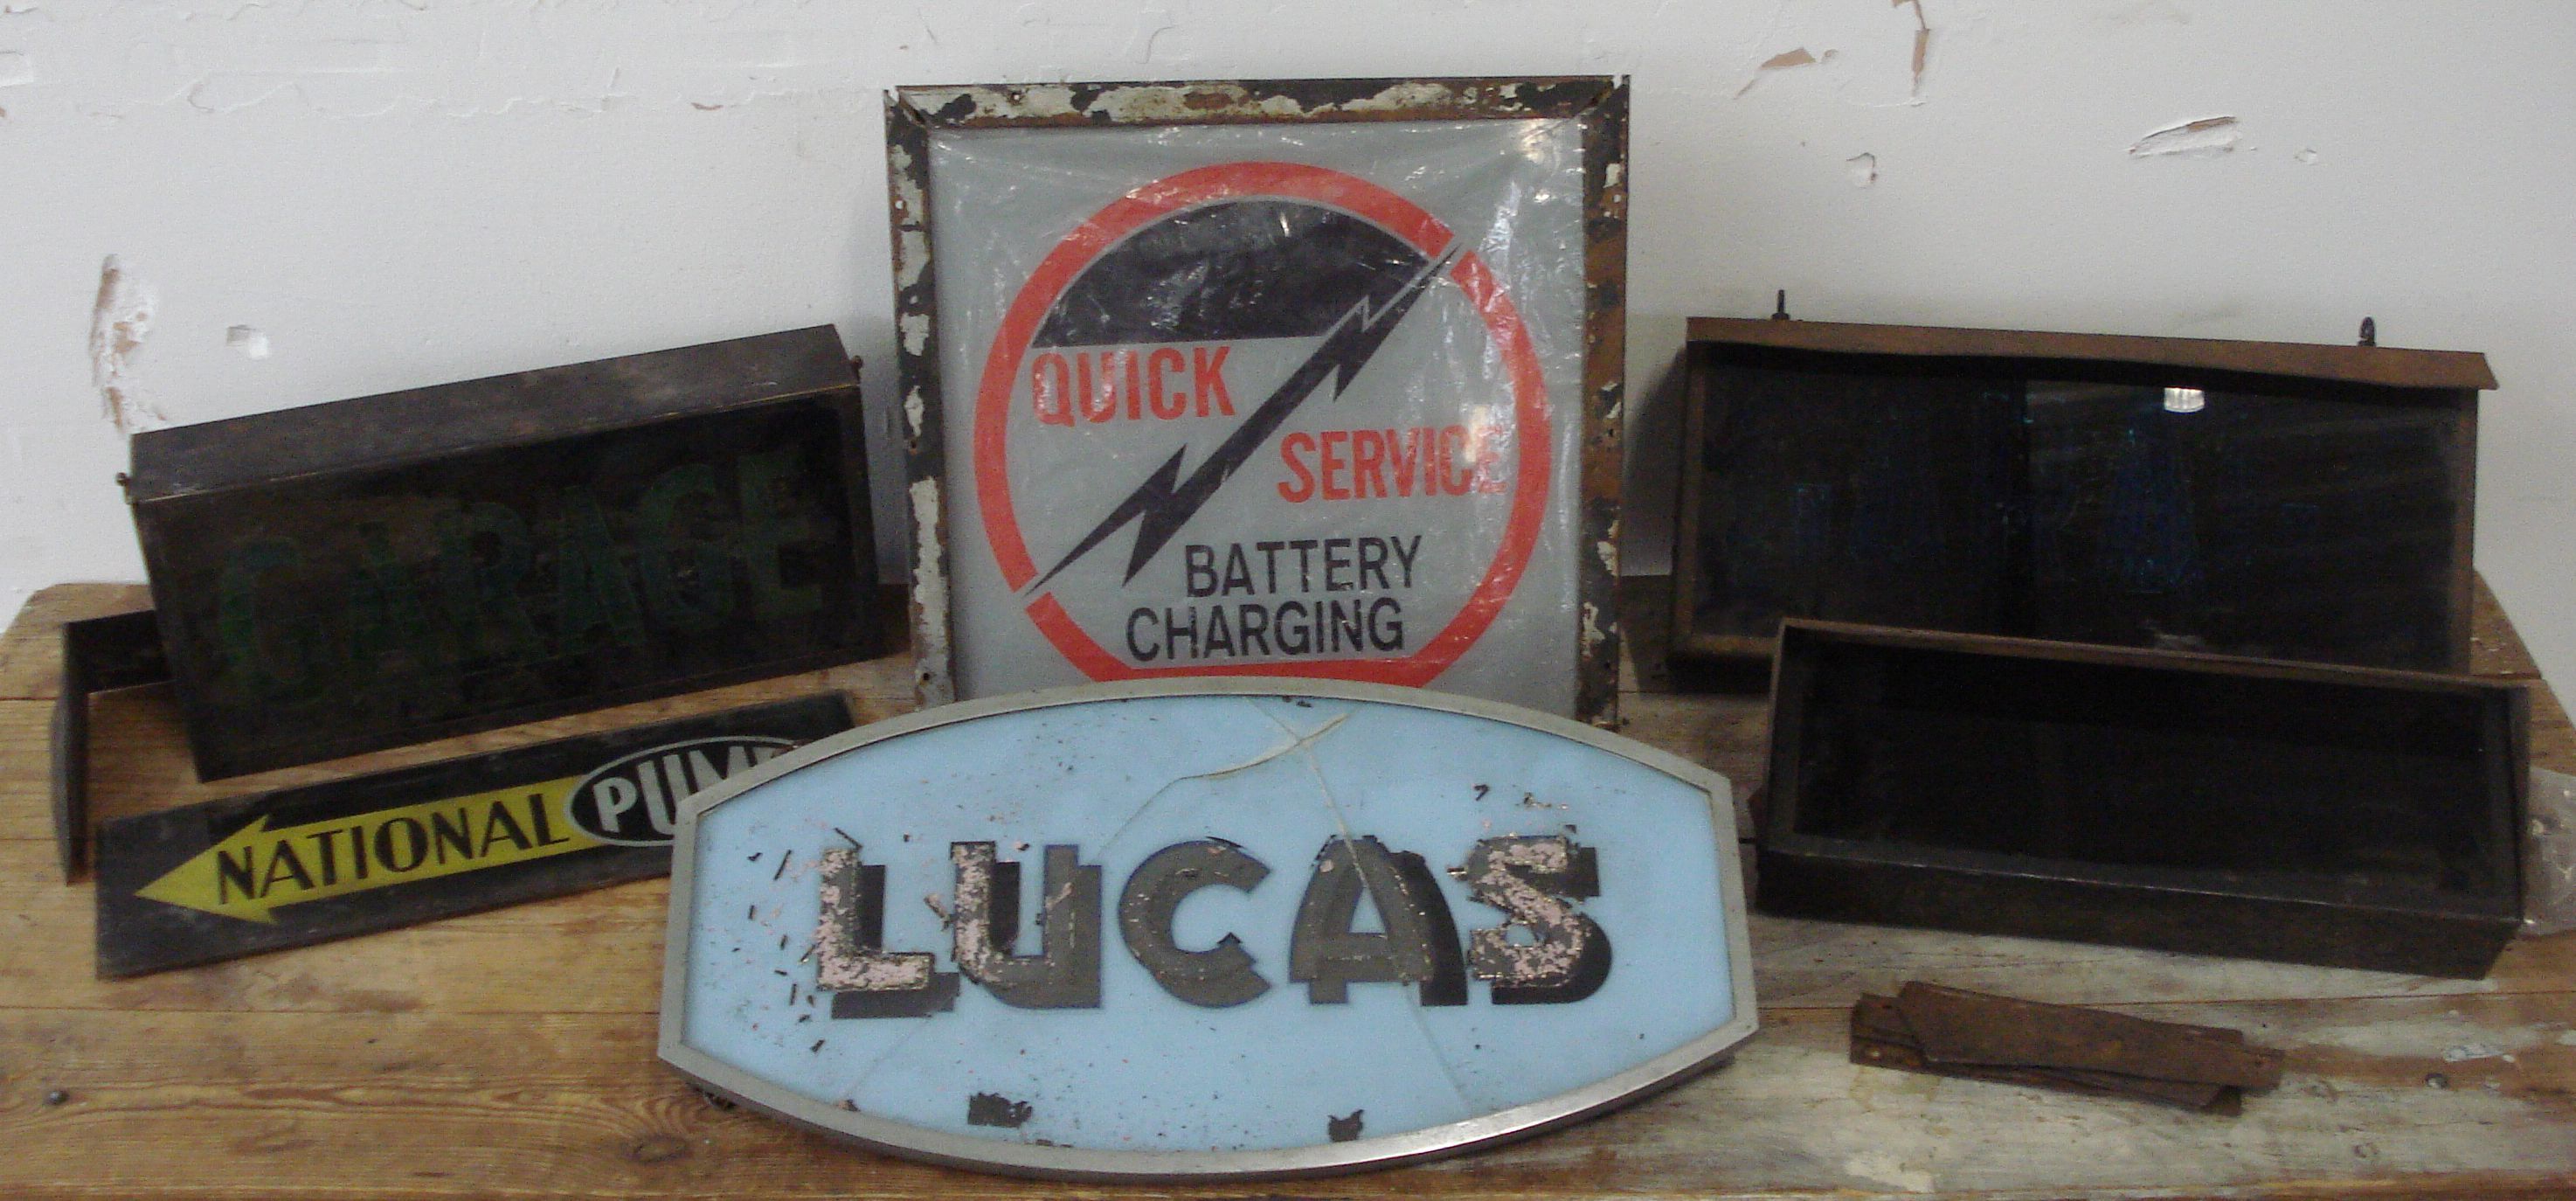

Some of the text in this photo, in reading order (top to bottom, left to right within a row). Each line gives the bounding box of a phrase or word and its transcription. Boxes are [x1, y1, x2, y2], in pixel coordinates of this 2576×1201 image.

[1033, 345, 1235, 426] QUICK
[1277, 425, 1506, 503] SERVICE
[217, 453, 821, 698] GARAGE
[1185, 535, 1422, 598] BATTERY
[1125, 598, 1404, 662] CHARGING
[215, 790, 570, 904] NATIONAL
[814, 834, 1613, 1018] LUCAS
